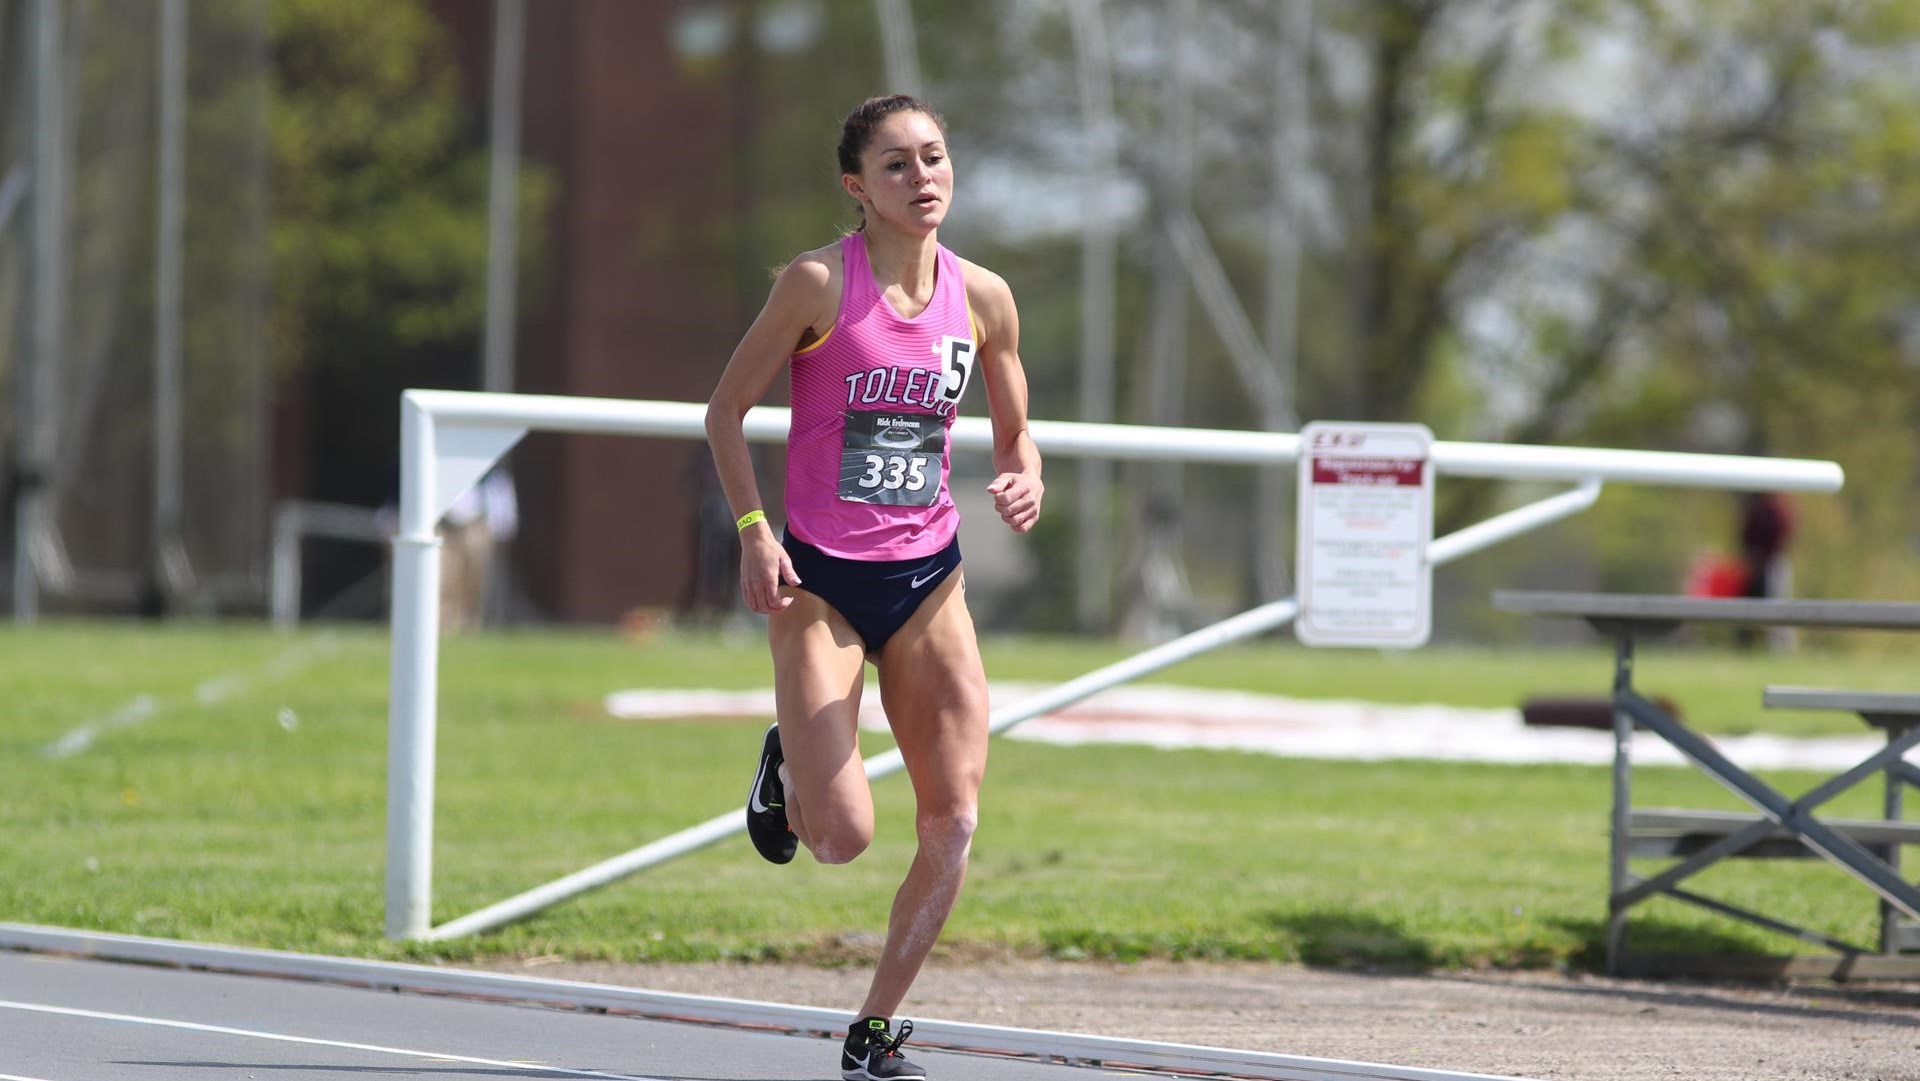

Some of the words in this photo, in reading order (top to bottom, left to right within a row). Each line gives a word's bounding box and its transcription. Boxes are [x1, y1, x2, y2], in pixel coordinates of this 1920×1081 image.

[944, 341, 971, 400] 5
[876, 417, 891, 427] Rick
[891, 418, 920, 429] Erdmann
[858, 454, 928, 491] 335
